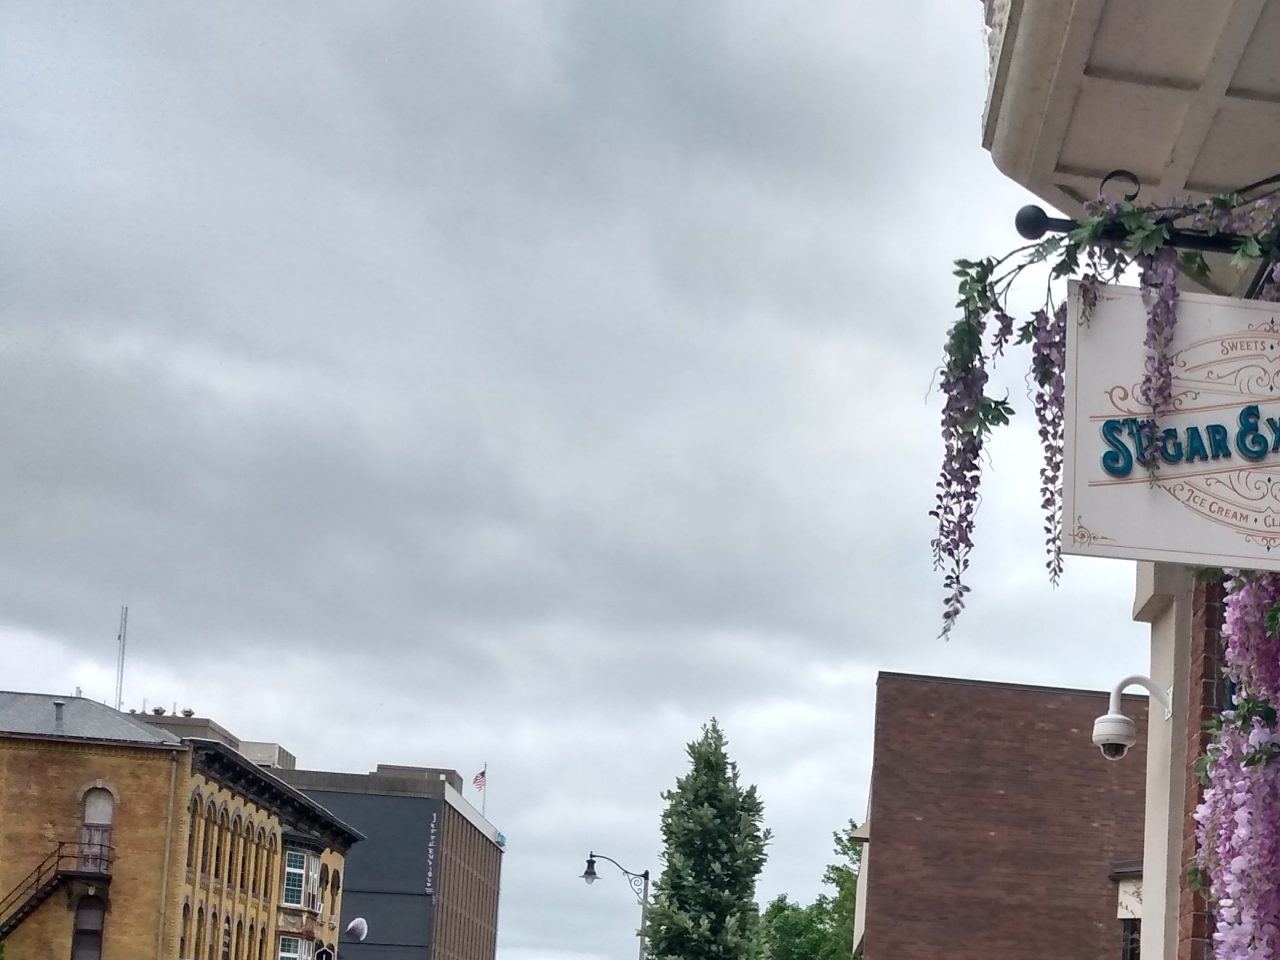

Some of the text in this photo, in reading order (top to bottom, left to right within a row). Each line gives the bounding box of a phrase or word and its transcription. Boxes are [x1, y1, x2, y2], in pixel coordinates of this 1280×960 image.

[1220, 340, 1267, 356] SWEETS
[1187, 488, 1205, 507] ICE
[1208, 500, 1249, 524] CREAM
